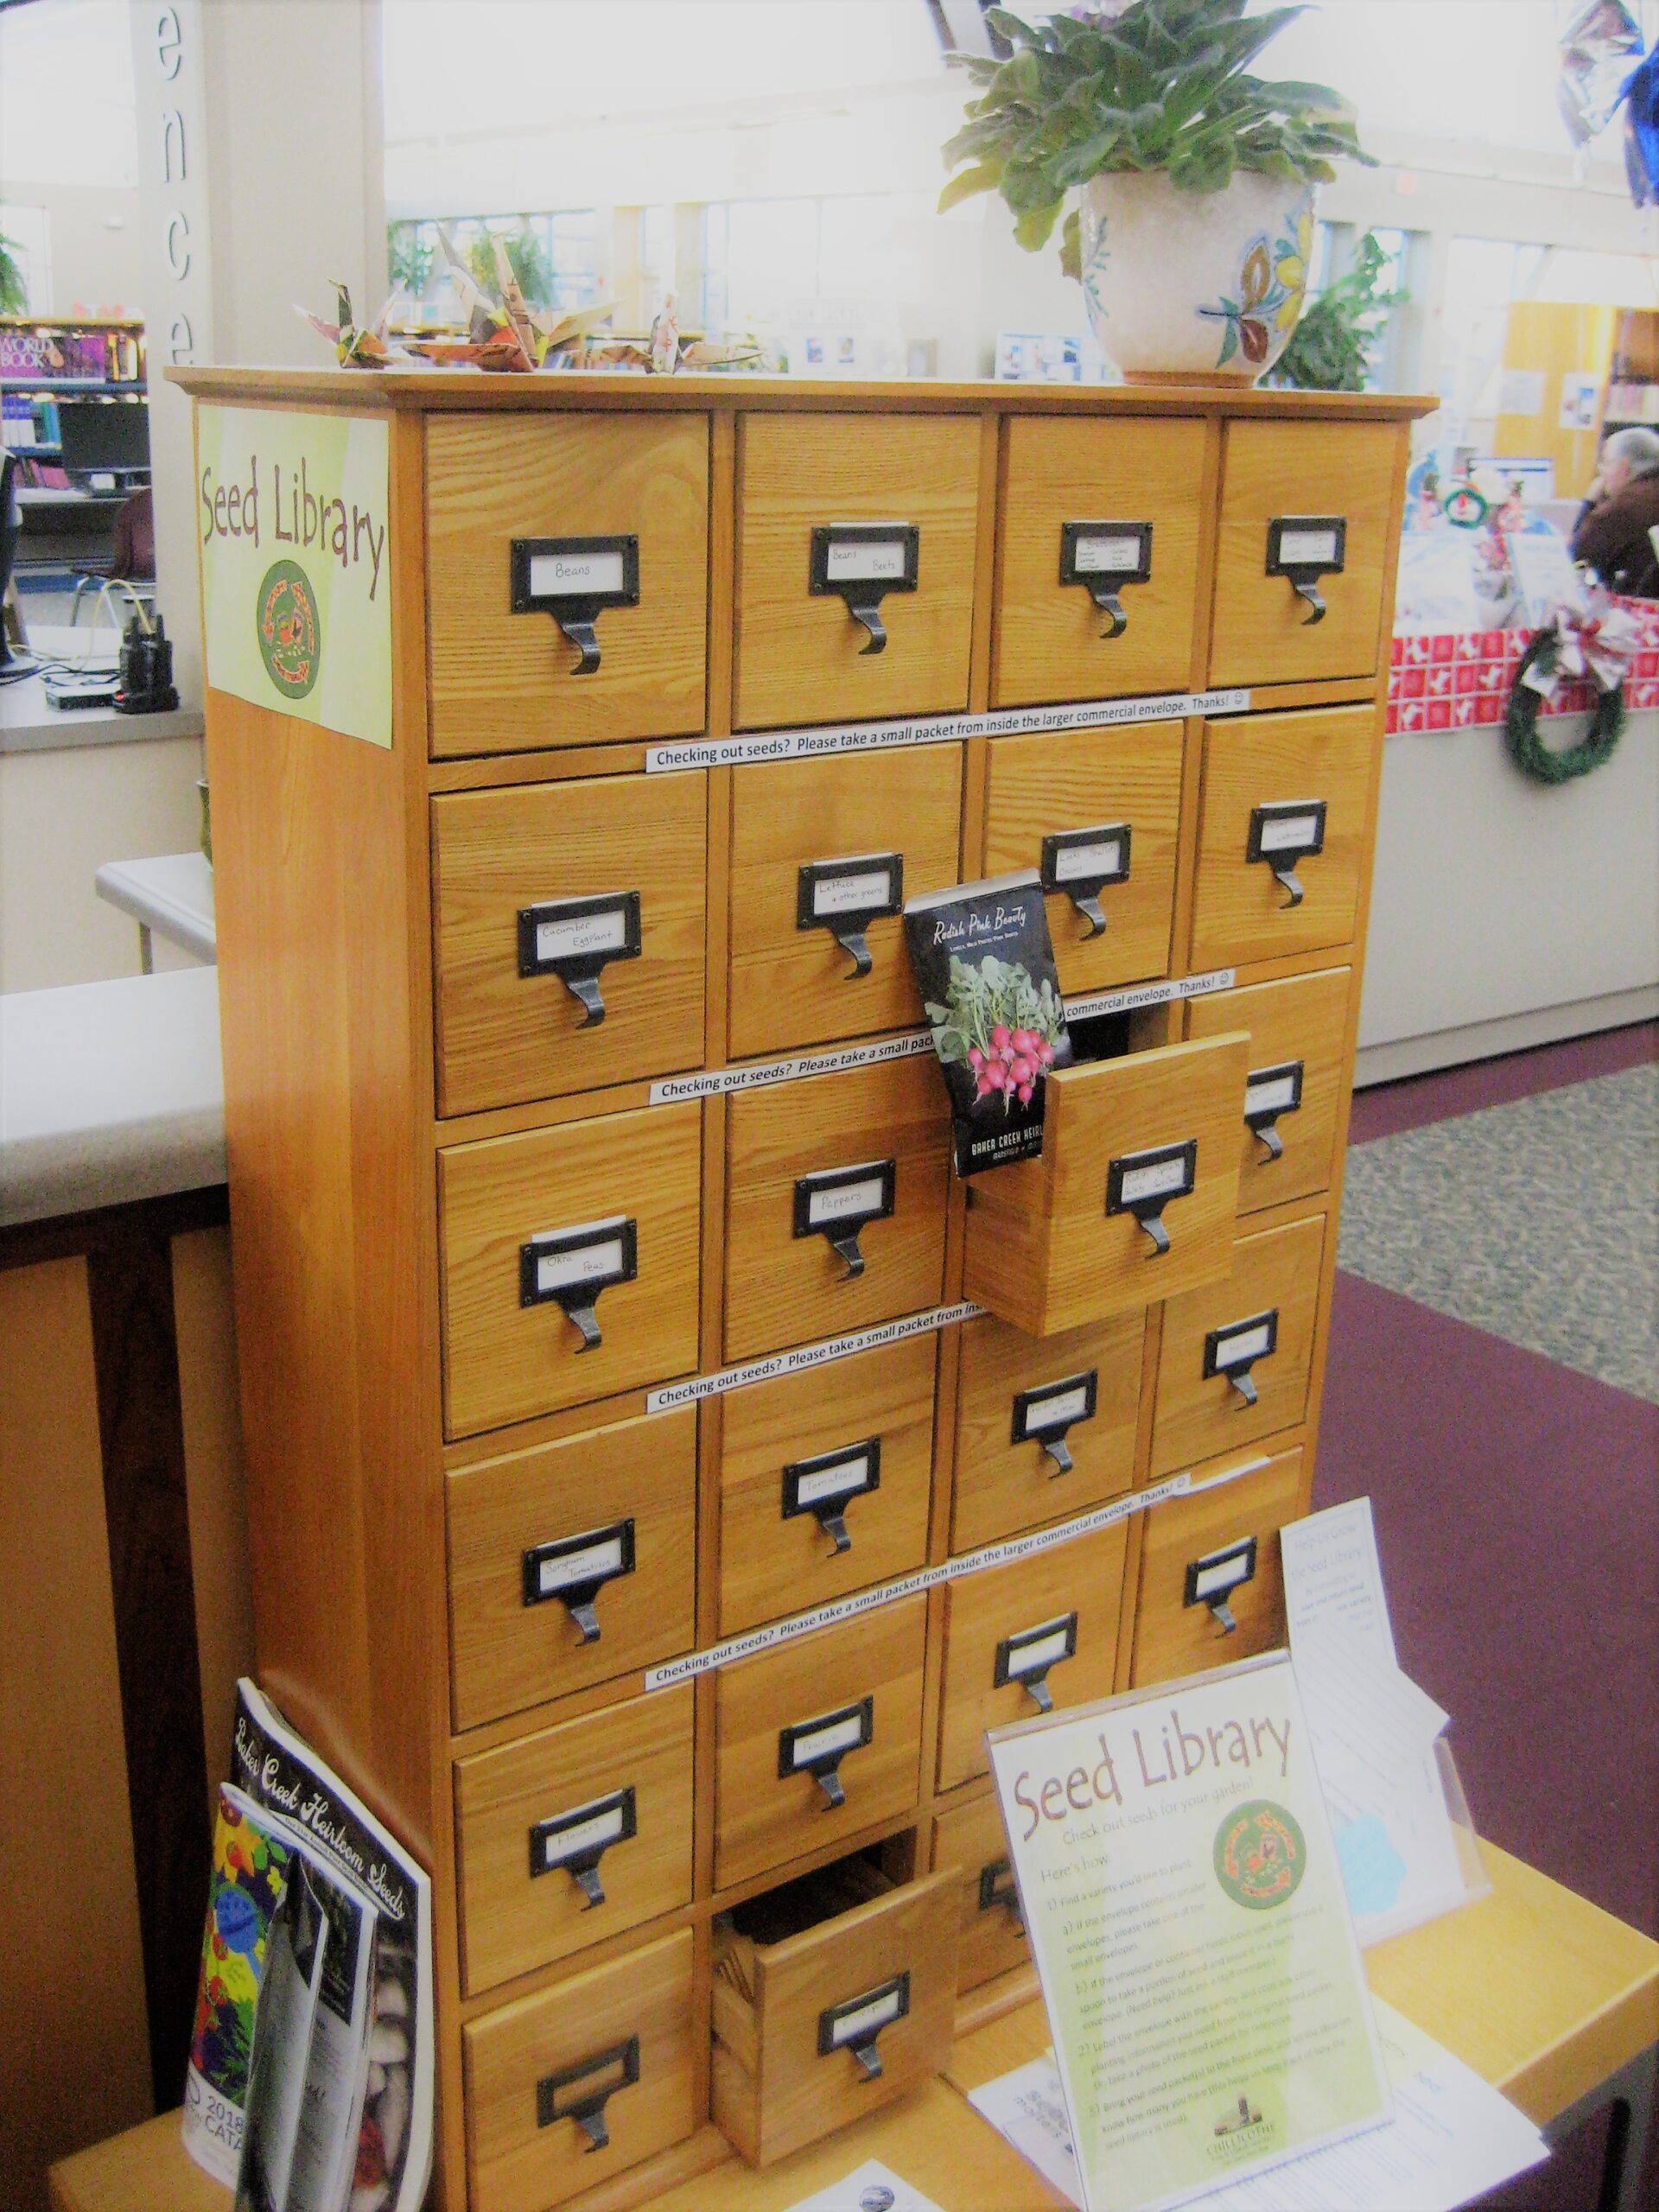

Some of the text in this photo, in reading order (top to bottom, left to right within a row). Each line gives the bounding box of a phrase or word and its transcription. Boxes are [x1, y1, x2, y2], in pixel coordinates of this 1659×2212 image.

[1, 353, 44, 367] BOOK
[201, 454, 385, 602] Seed Library
[556, 563, 590, 578] Beans
[657, 696, 1229, 765] Checking out seeds? Please take a small packet from inside the larger commercial envelope. Thanks!
[819, 879, 855, 893] Lettuce
[839, 892, 858, 901] other
[542, 921, 591, 938] Cucumber
[573, 929, 613, 948] Eggplant
[933, 920, 966, 946] Radish
[969, 912, 992, 937] Pink
[993, 906, 1027, 931] Beauty
[1066, 976, 1215, 1016] commercial envelope. Thanks!
[662, 1078, 721, 1096] Checking
[724, 1073, 746, 1085] out
[749, 1064, 792, 1081] seeds?
[799, 1058, 837, 1072] Please
[841, 1051, 866, 1065] take
[868, 1050, 875, 1058] a
[879, 1039, 908, 1057] small
[971, 1138, 996, 1156] BAKER
[998, 1130, 1021, 1148] CREEK
[547, 1255, 573, 1268] Okra
[658, 1309, 962, 1404] Checking out seeds? Please take a small packet from
[656, 1484, 1173, 1681] Checking out seeds? Please take a small packet from inside the larger commercial envelope. Thanks!
[1014, 1708, 1291, 1842] Seed Library
[235, 1717, 259, 1776] Baker
[262, 1753, 302, 1810] Creek
[301, 1792, 365, 1872] Heirloom
[367, 1863, 406, 1920] Seeds
[1063, 1777, 1253, 1846] Check out seeds for your garden!
[1040, 1862, 1080, 1883] Here's
[1101, 1904, 1140, 1923] envelope
[1070, 1955, 1094, 1972] small
[207, 2095, 244, 2134] 2018
